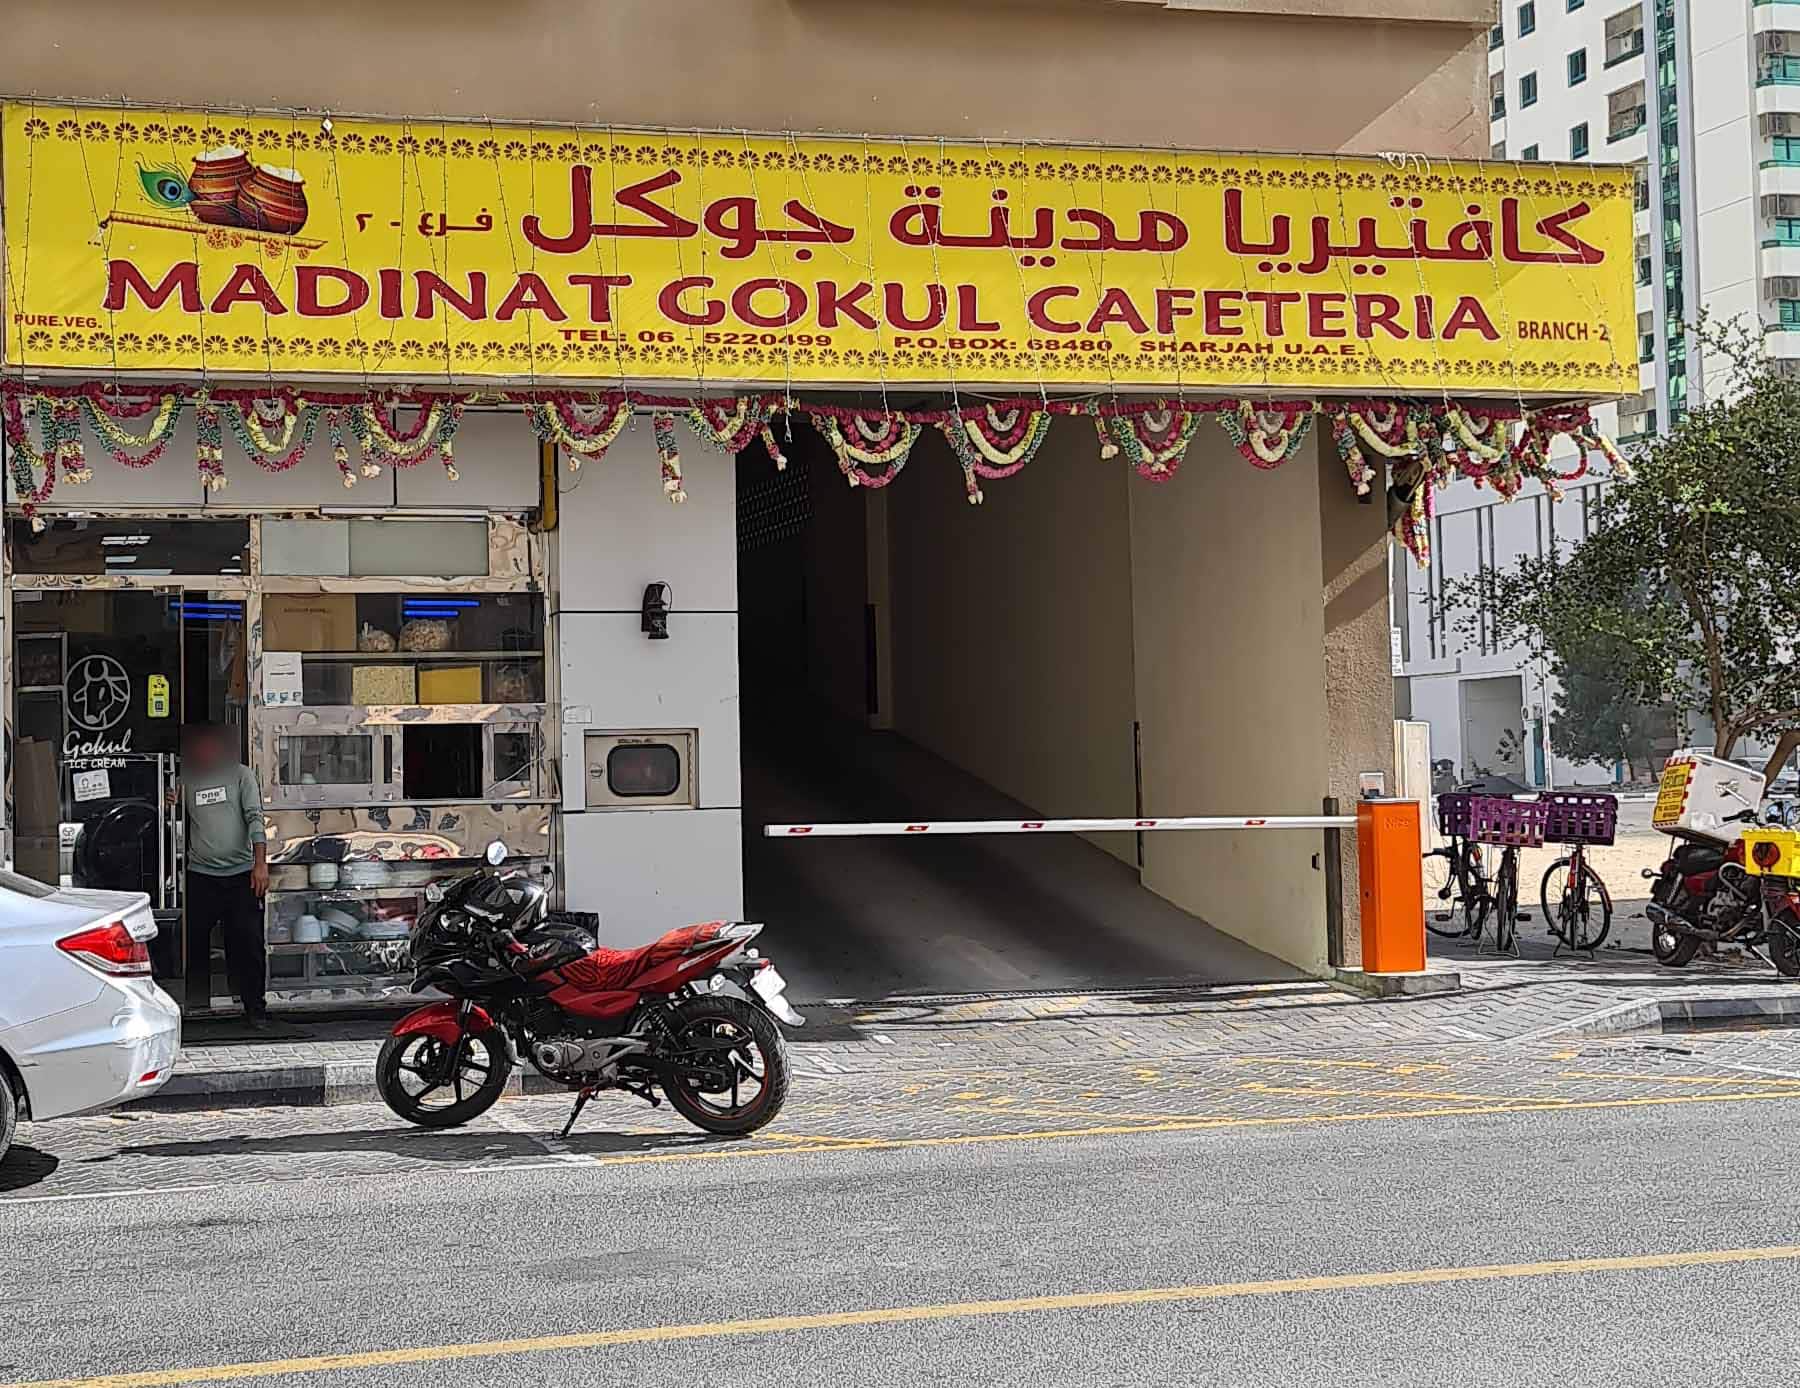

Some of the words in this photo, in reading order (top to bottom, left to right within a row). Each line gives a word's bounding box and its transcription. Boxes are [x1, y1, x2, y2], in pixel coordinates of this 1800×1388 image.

[417, 207, 493, 237] فرع
[522, 164, 856, 262] جوكل
[889, 185, 1189, 268] مدينة
[1223, 189, 1605, 277] كافتيريا
[103, 259, 633, 323] MADINAT
[658, 276, 1001, 332] GOKUL
[1027, 285, 1499, 341] CAFETERIA
[559, 329, 626, 343] TEL:
[638, 331, 674, 343] 06
[704, 332, 832, 347] 5220499
[894, 336, 1017, 351] P.O.BOX:
[1027, 339, 1112, 352] 68480
[1140, 340, 1273, 354] SHARJAH
[1284, 343, 1364, 356] U.A.E.
[1517, 321, 1588, 340] BRANCH
[63, 728, 131, 759] Gokul
[69, 758, 87, 769] ICE
[91, 757, 126, 769] CREAM
